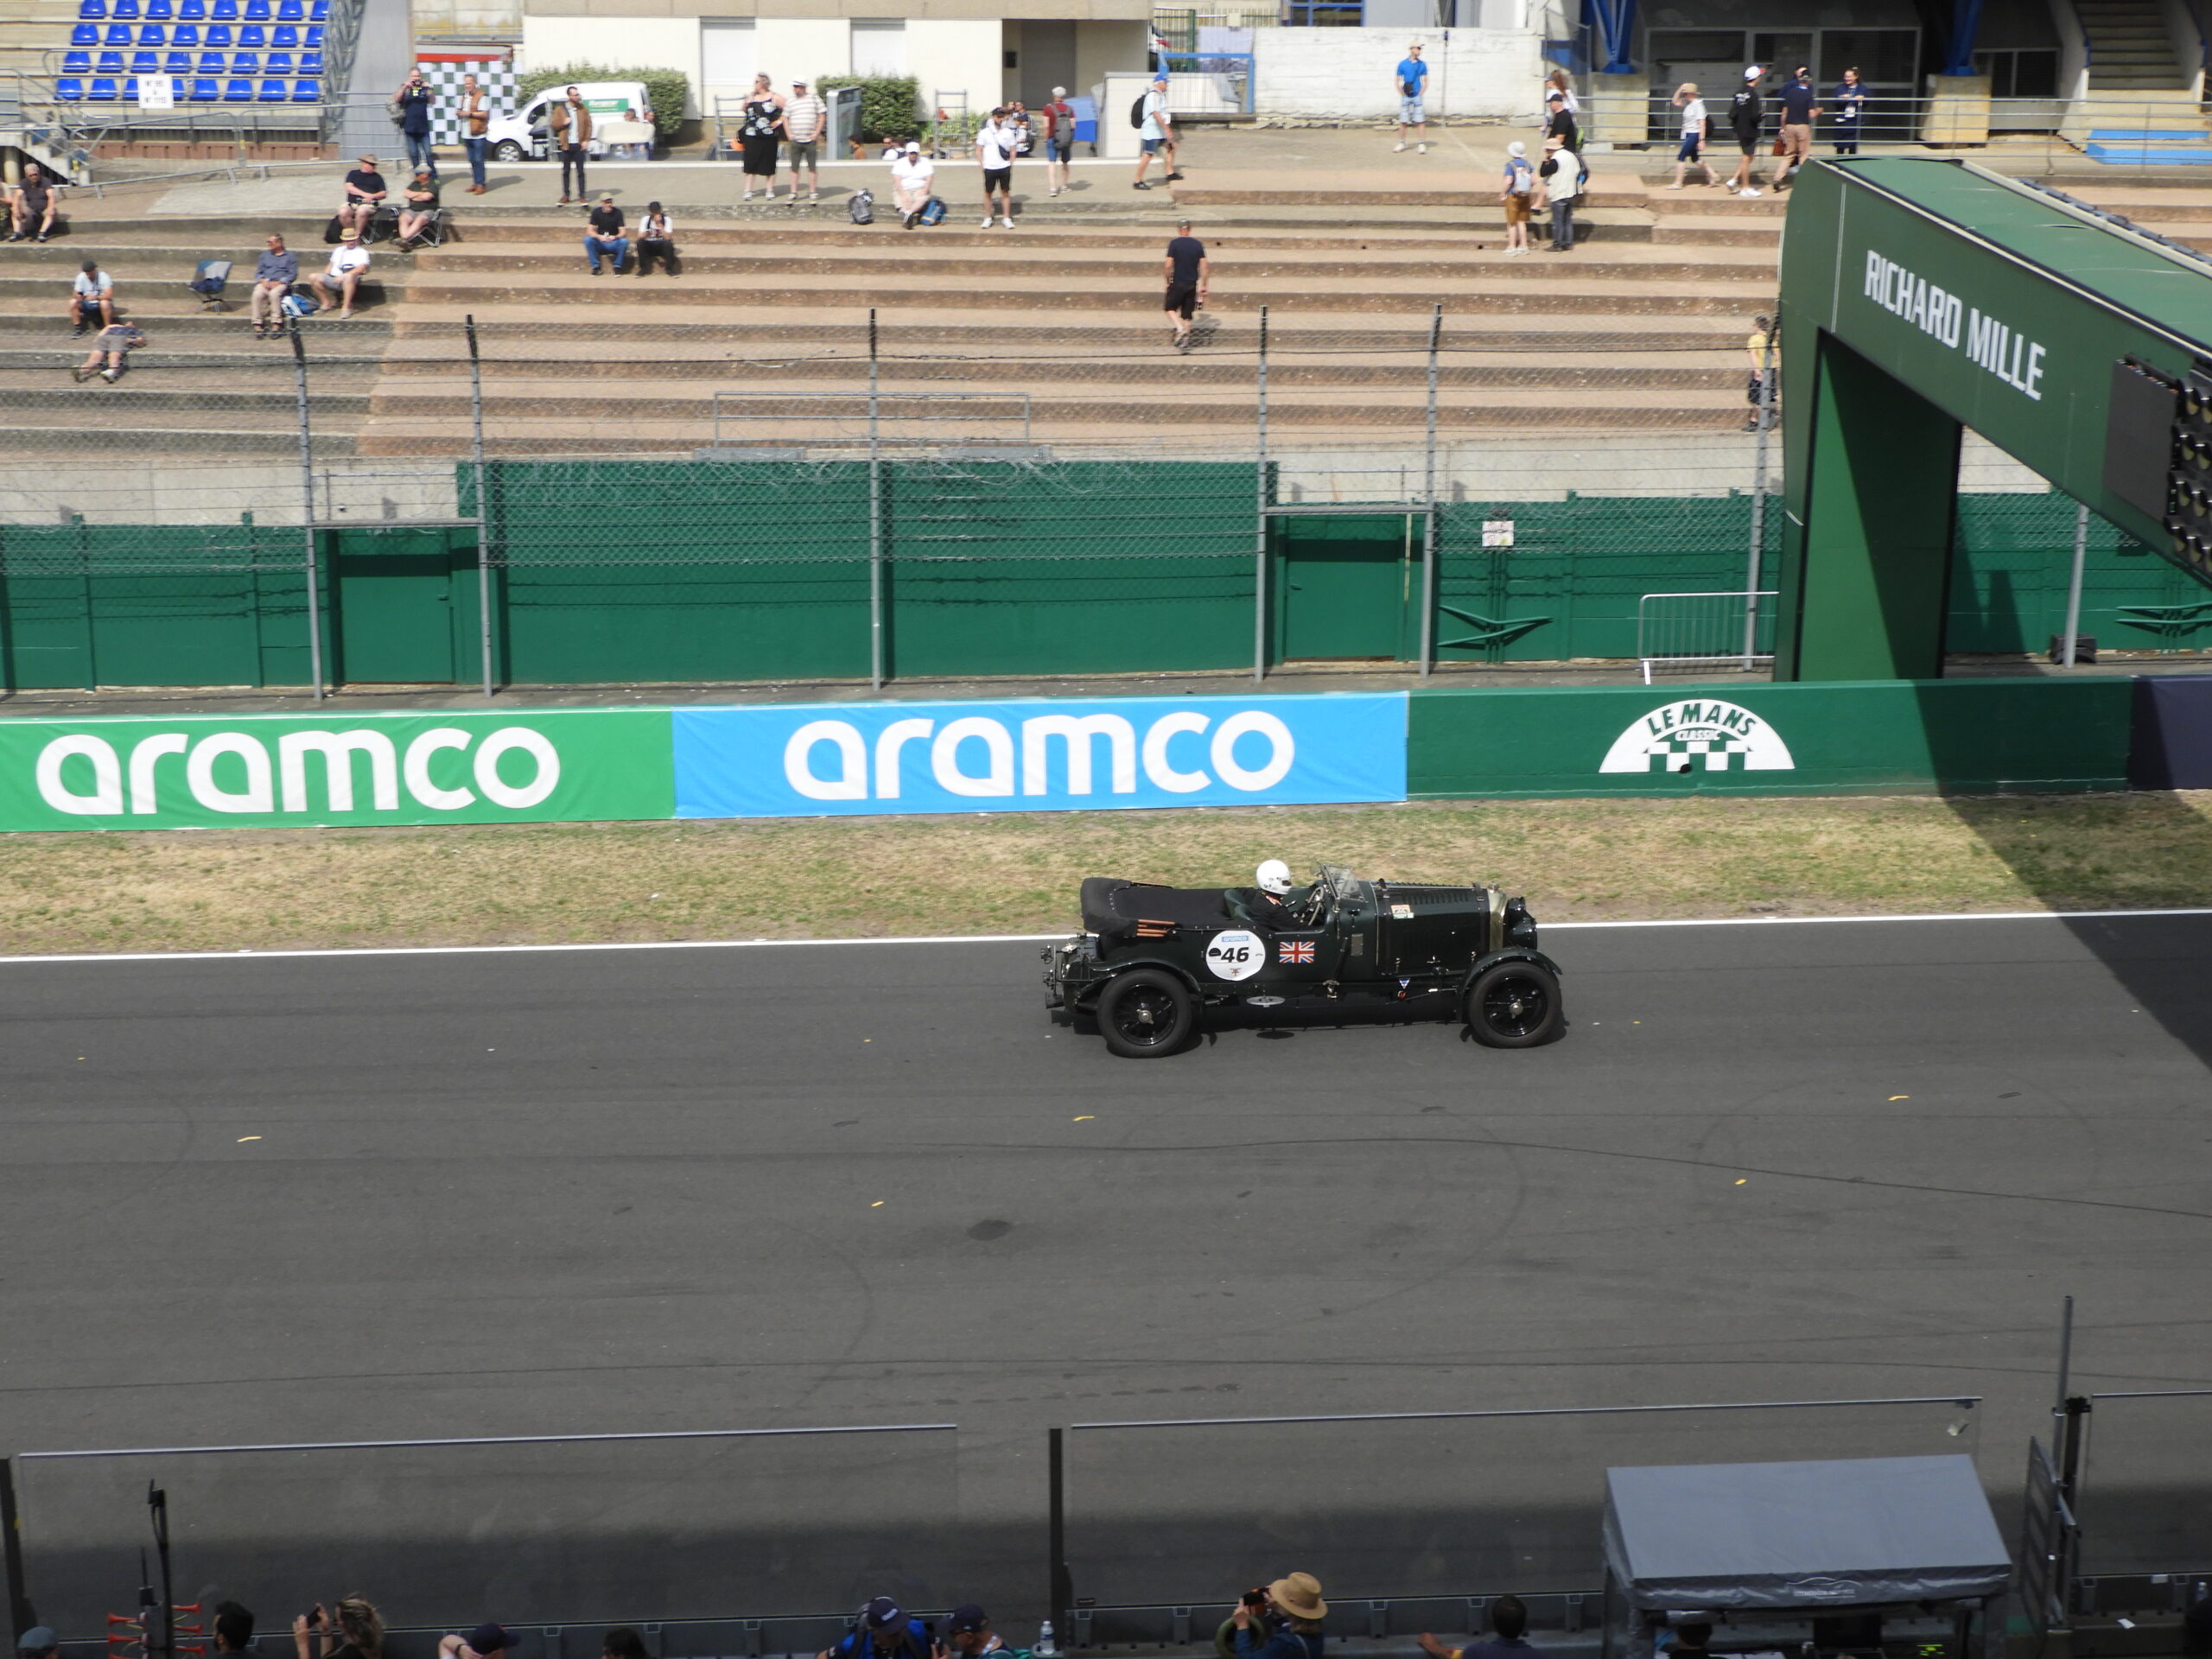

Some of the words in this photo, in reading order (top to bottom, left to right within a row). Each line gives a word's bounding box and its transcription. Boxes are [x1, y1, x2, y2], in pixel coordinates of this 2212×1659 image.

[1864, 249, 1962, 349] RICHARD
[1966, 307, 2046, 401] MILLE
[1647, 709, 1674, 736] LE
[1680, 702, 1757, 736] MANS
[1675, 729, 1722, 741] CLASSIC
[35, 726, 561, 816] aramco
[784, 710, 1295, 800] aramco
[1221, 946, 1249, 963] 46
